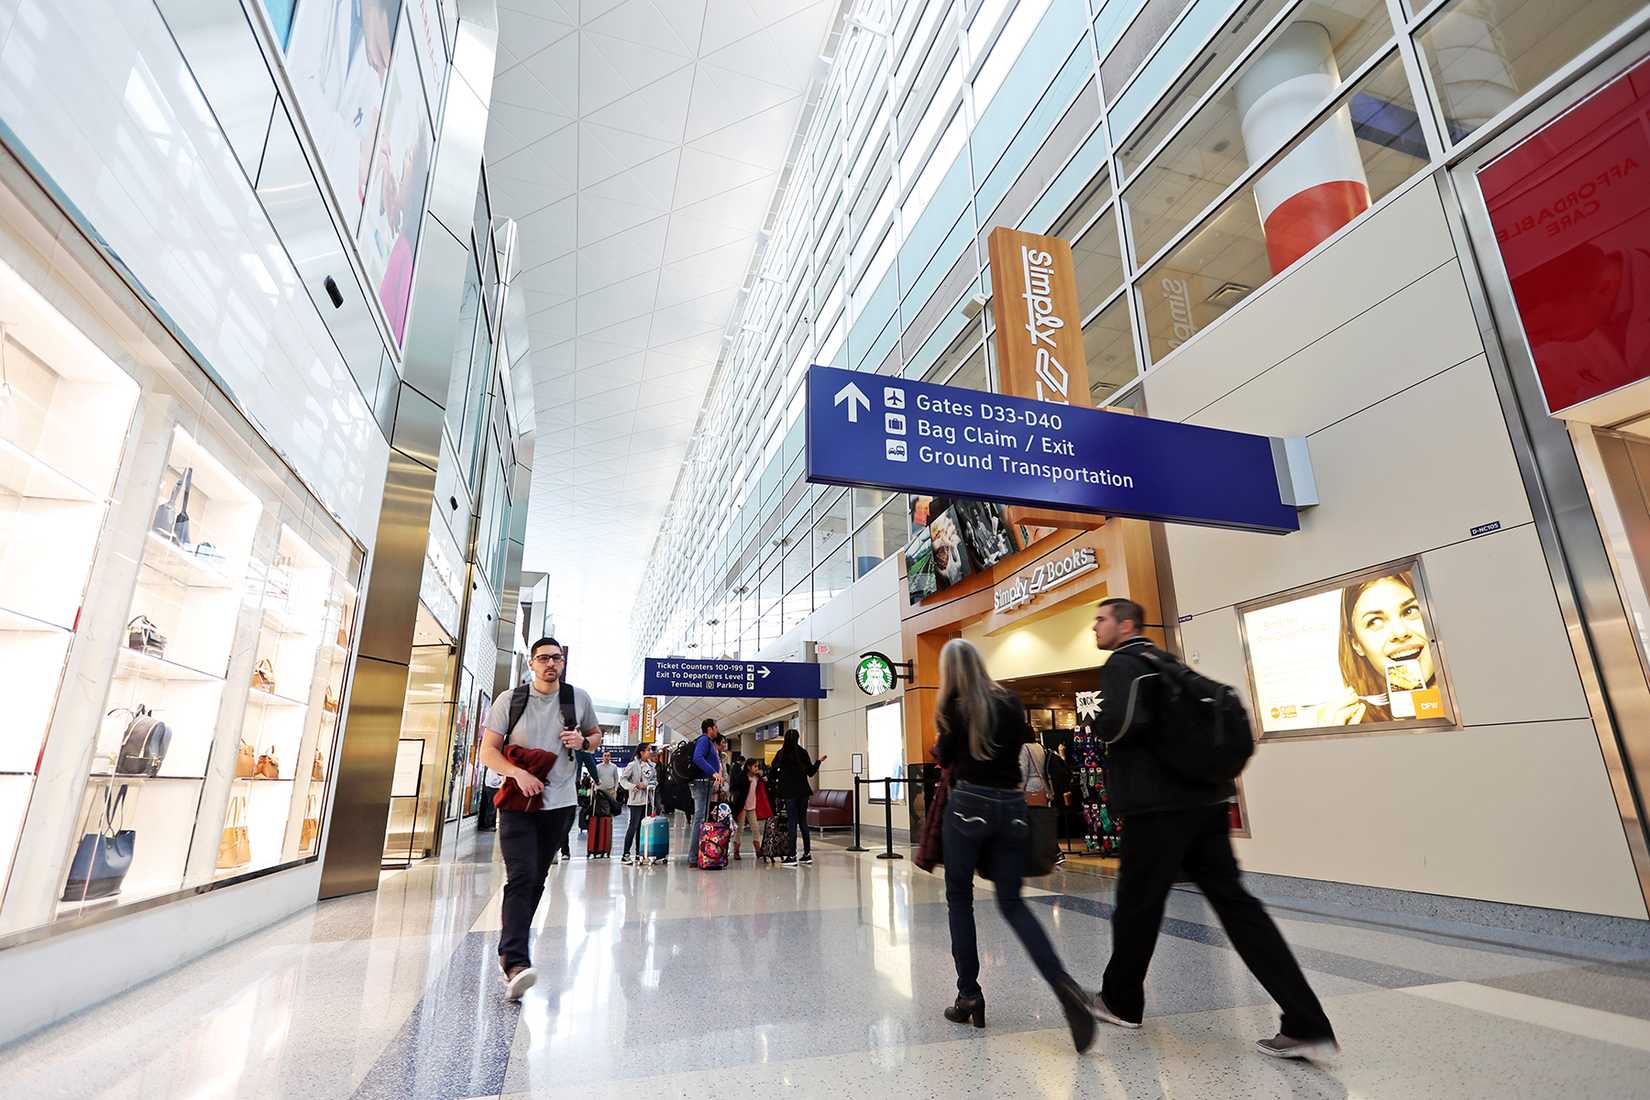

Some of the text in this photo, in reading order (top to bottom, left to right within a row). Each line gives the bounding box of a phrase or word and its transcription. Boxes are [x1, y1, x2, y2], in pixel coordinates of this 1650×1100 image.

[917, 394, 1062, 430] Gates D33-D40
[918, 419, 1075, 456] Bag Claim / Exit
[919, 446, 1134, 488] Ground Transportation
[656, 662, 744, 672] Ticket Counters 100-199
[671, 671, 681, 679] To
[683, 671, 722, 680] Departures
[724, 672, 744, 680] Level
[671, 680, 703, 688] Terminal
[716, 681, 743, 690] Parking
